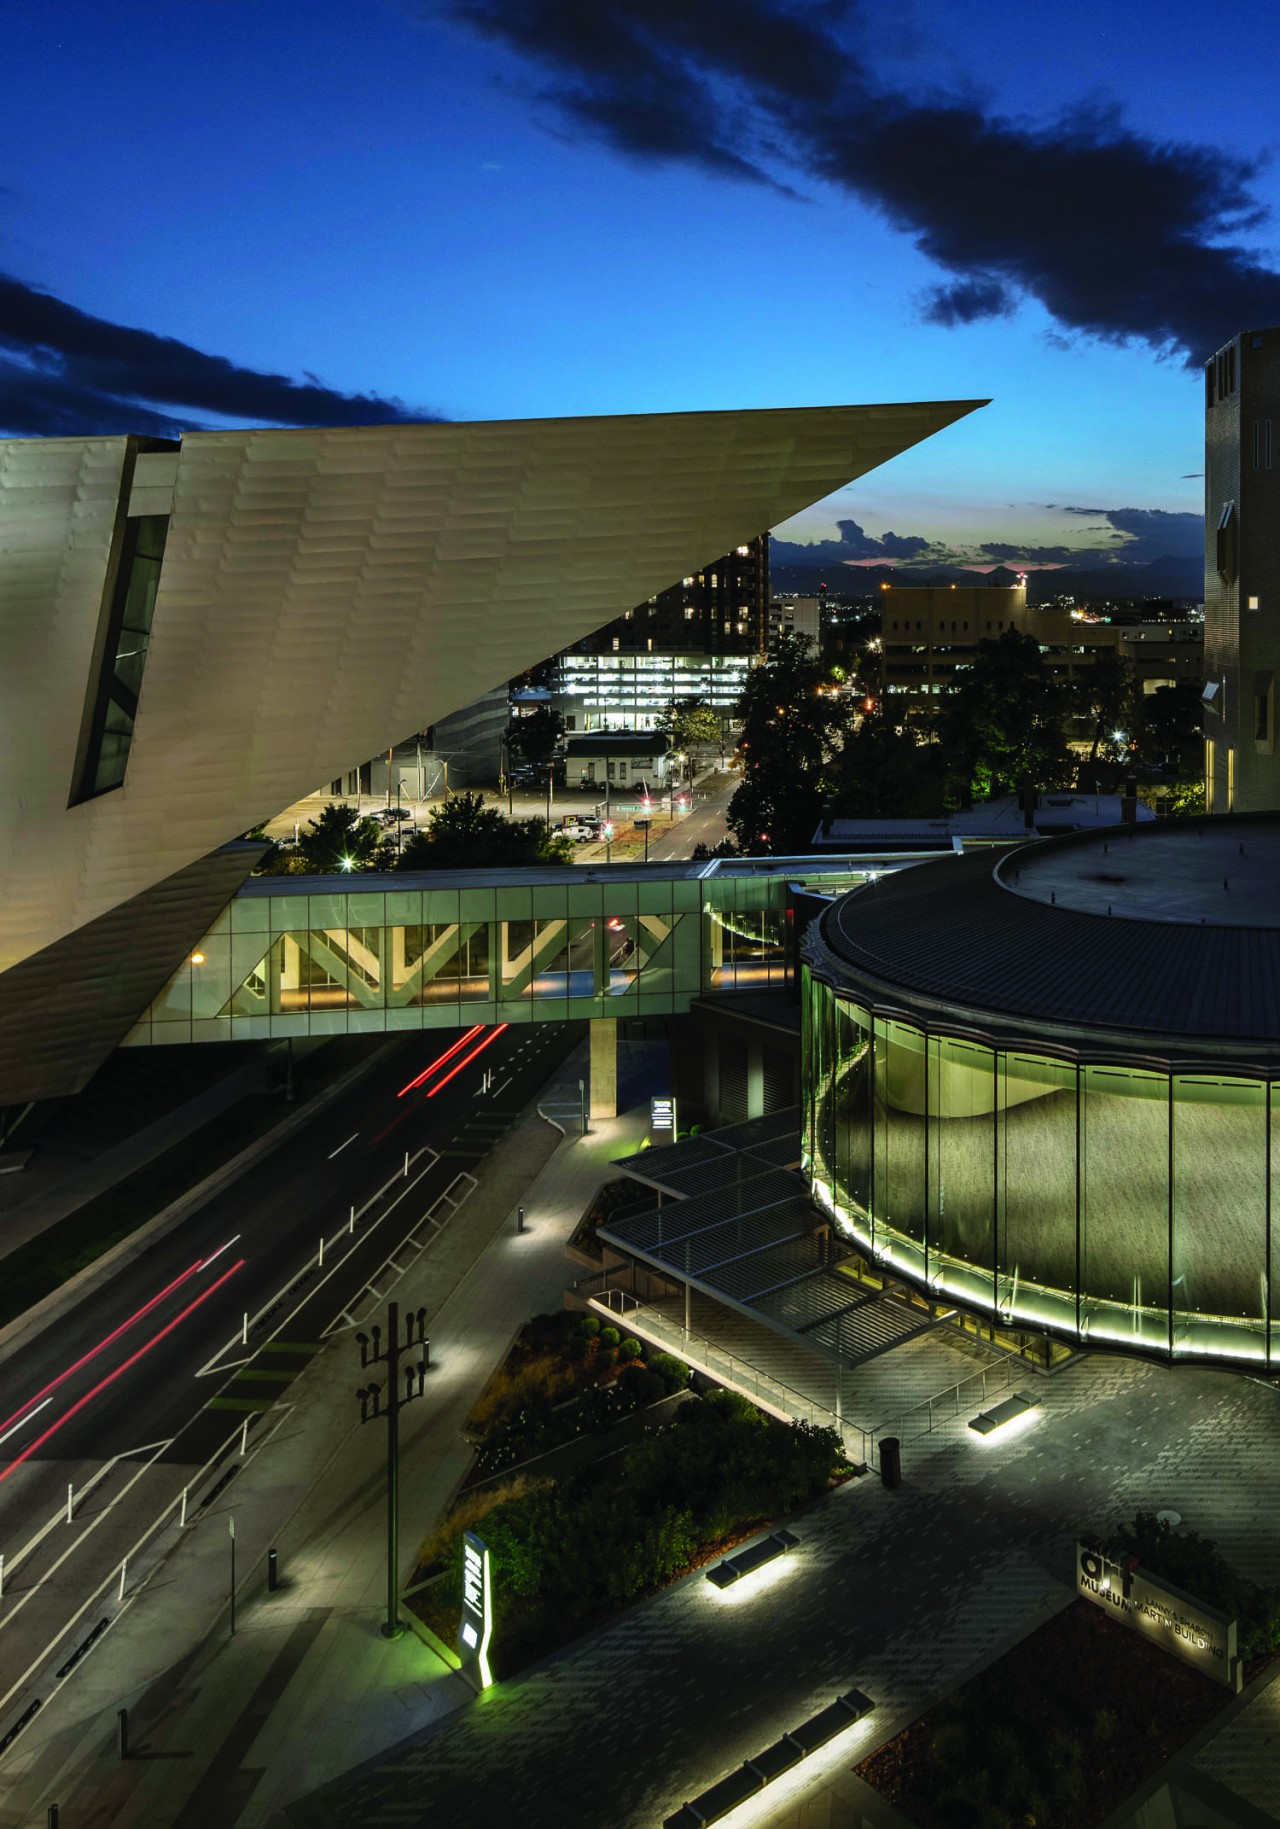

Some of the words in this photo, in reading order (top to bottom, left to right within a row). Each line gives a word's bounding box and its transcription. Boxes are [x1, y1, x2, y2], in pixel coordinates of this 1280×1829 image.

[1081, 1575, 1132, 1614] MUSEUM
[1135, 1600, 1172, 1630] MARTIN
[1174, 1623, 1224, 1659] BUILDING
[1145, 1597, 1172, 1618] LANNY
[1179, 1617, 1214, 1641] SHARON
